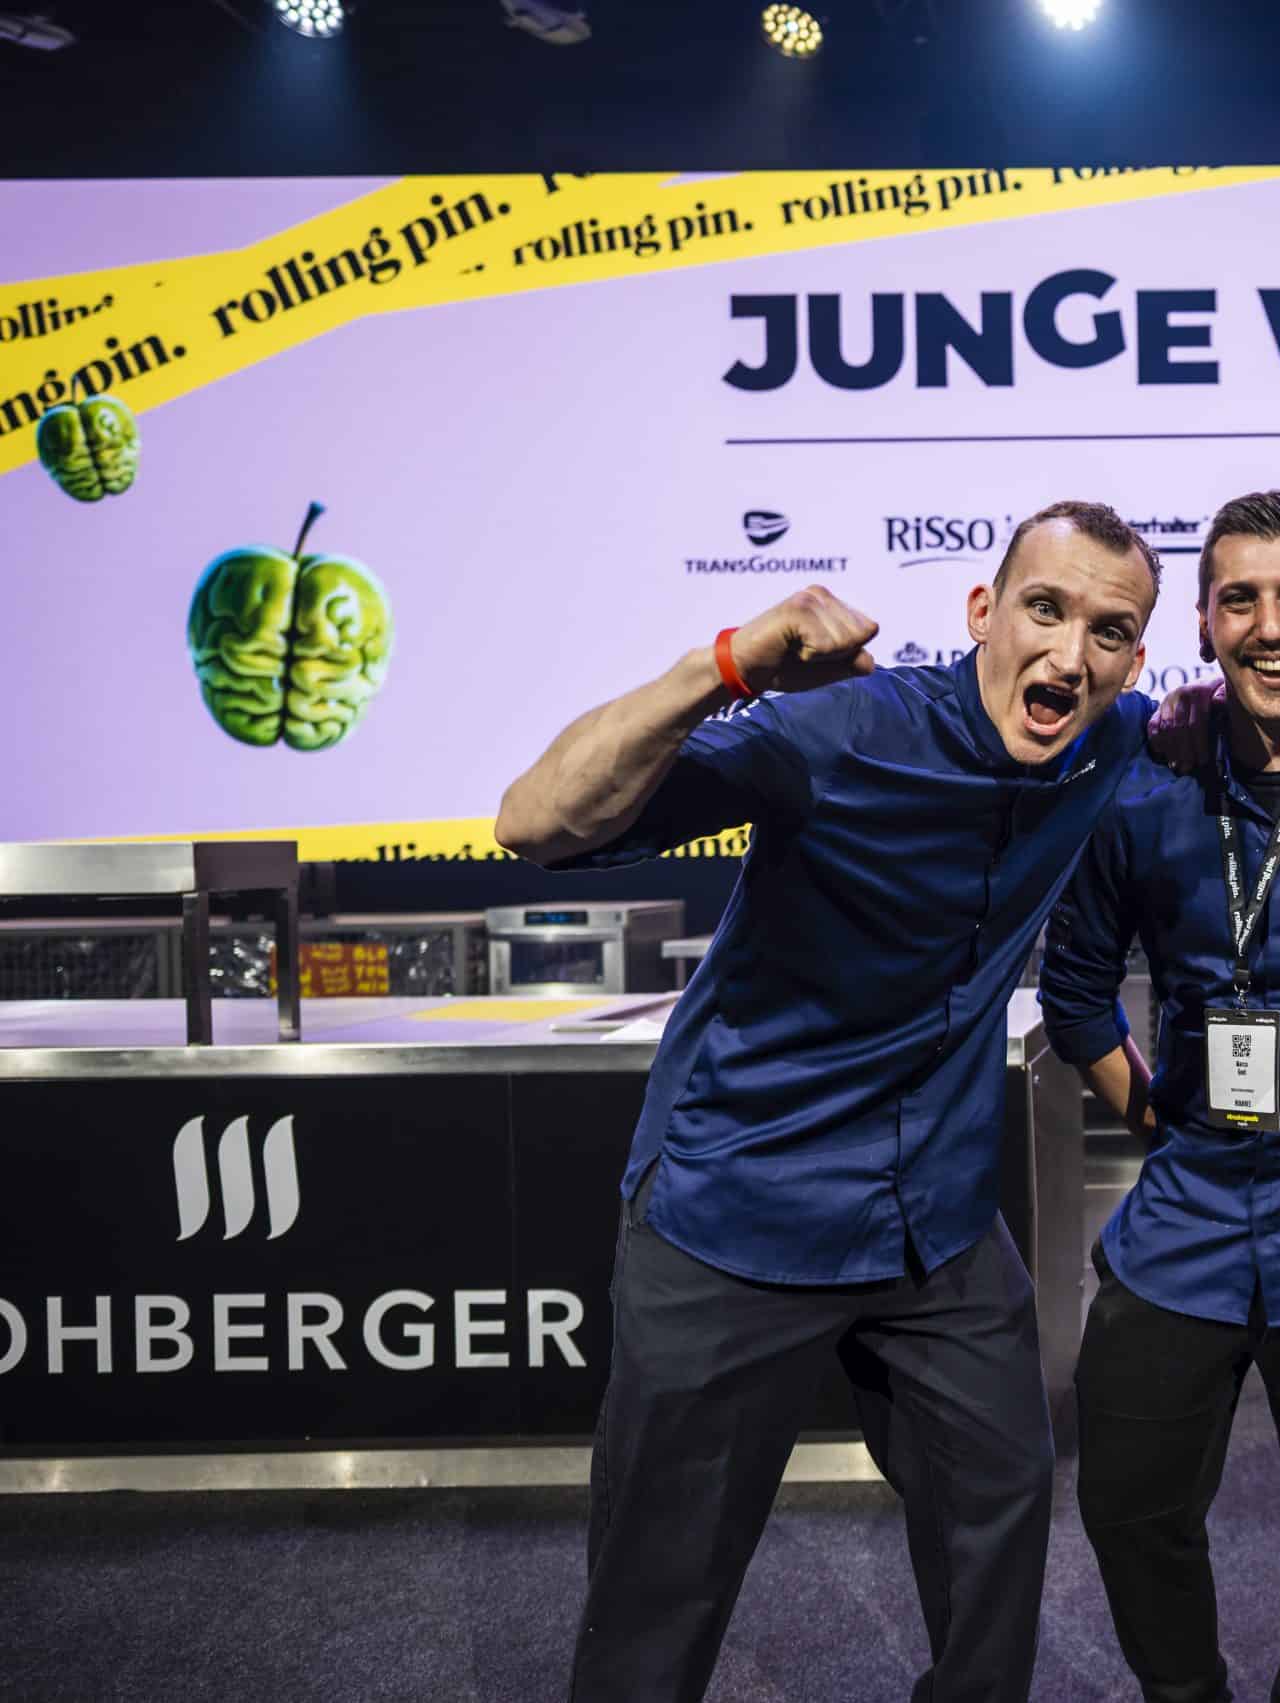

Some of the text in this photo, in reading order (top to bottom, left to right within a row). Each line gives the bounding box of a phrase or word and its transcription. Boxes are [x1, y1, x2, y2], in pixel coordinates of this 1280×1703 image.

[512, 201, 754, 266] rolling pin.
[780, 173, 931, 226] rolling
[211, 190, 511, 338] rolling pin.
[722, 268, 1220, 392] JUNGE
